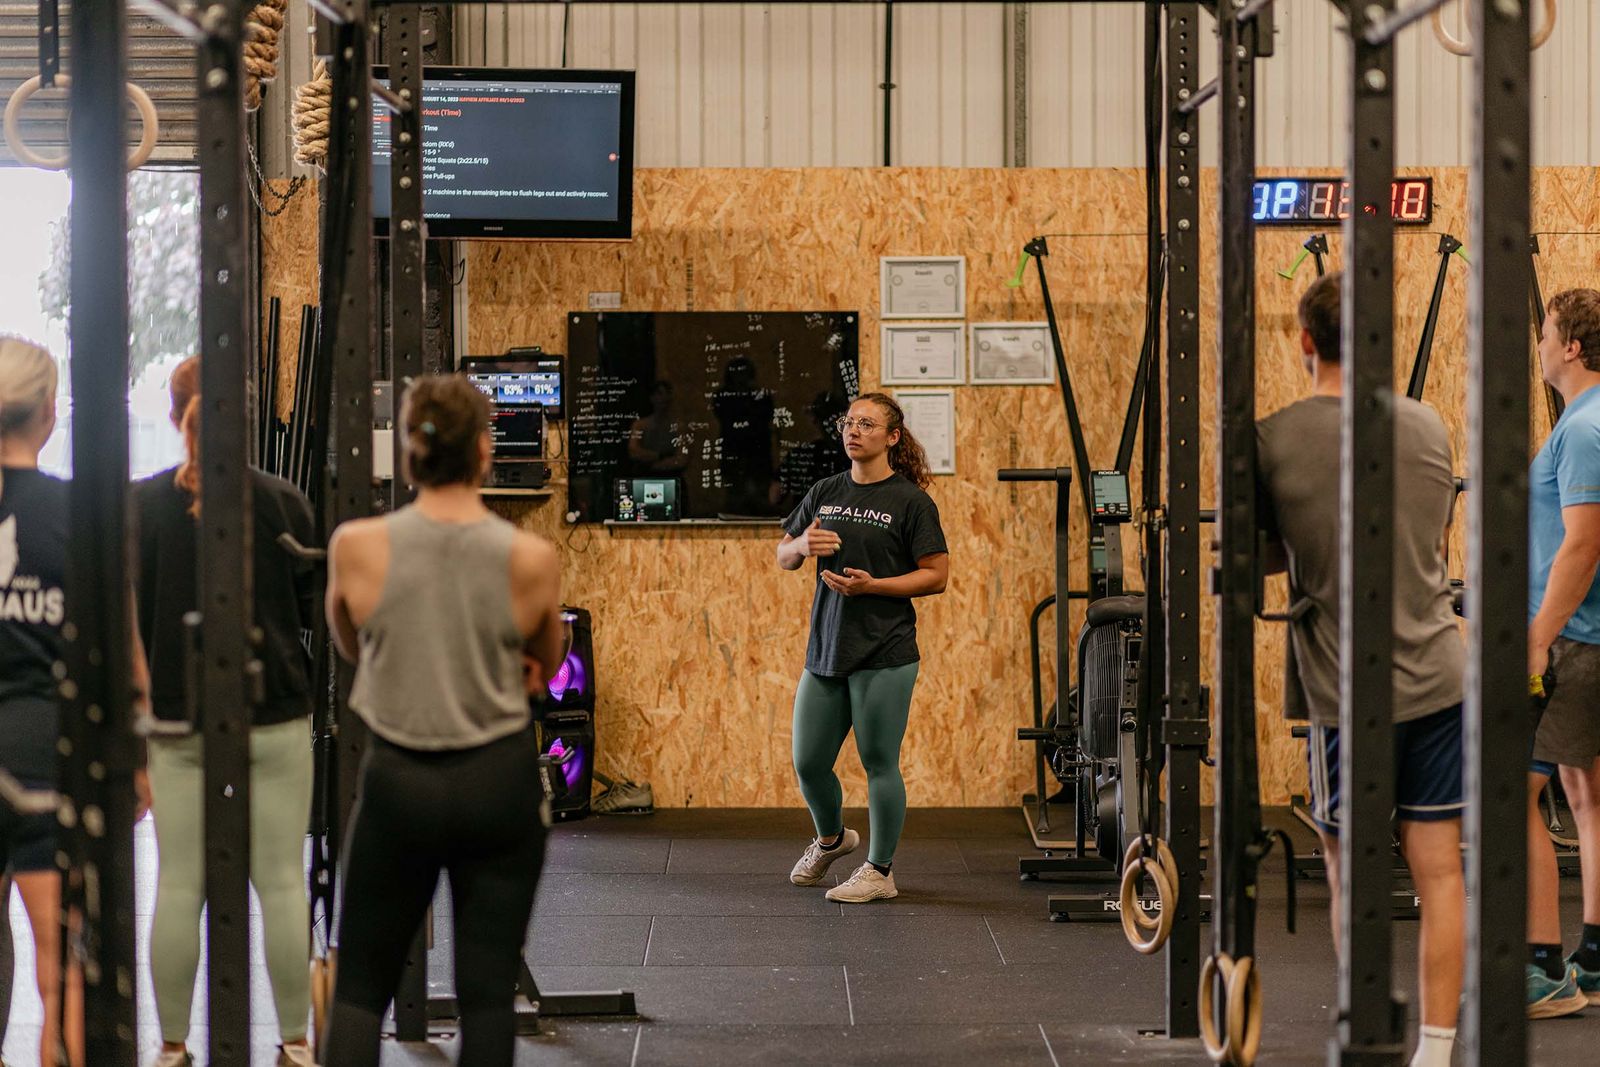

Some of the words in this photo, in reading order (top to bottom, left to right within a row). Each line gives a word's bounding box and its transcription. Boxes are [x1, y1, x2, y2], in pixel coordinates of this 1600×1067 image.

[441, 109, 462, 117] (Time)
[433, 173, 455, 181] Pull-ups
[432, 188, 456, 196] machine
[472, 189, 499, 198] remaining
[566, 190, 587, 198] actively
[504, 384, 524, 396] 63%
[534, 384, 554, 395] 61%
